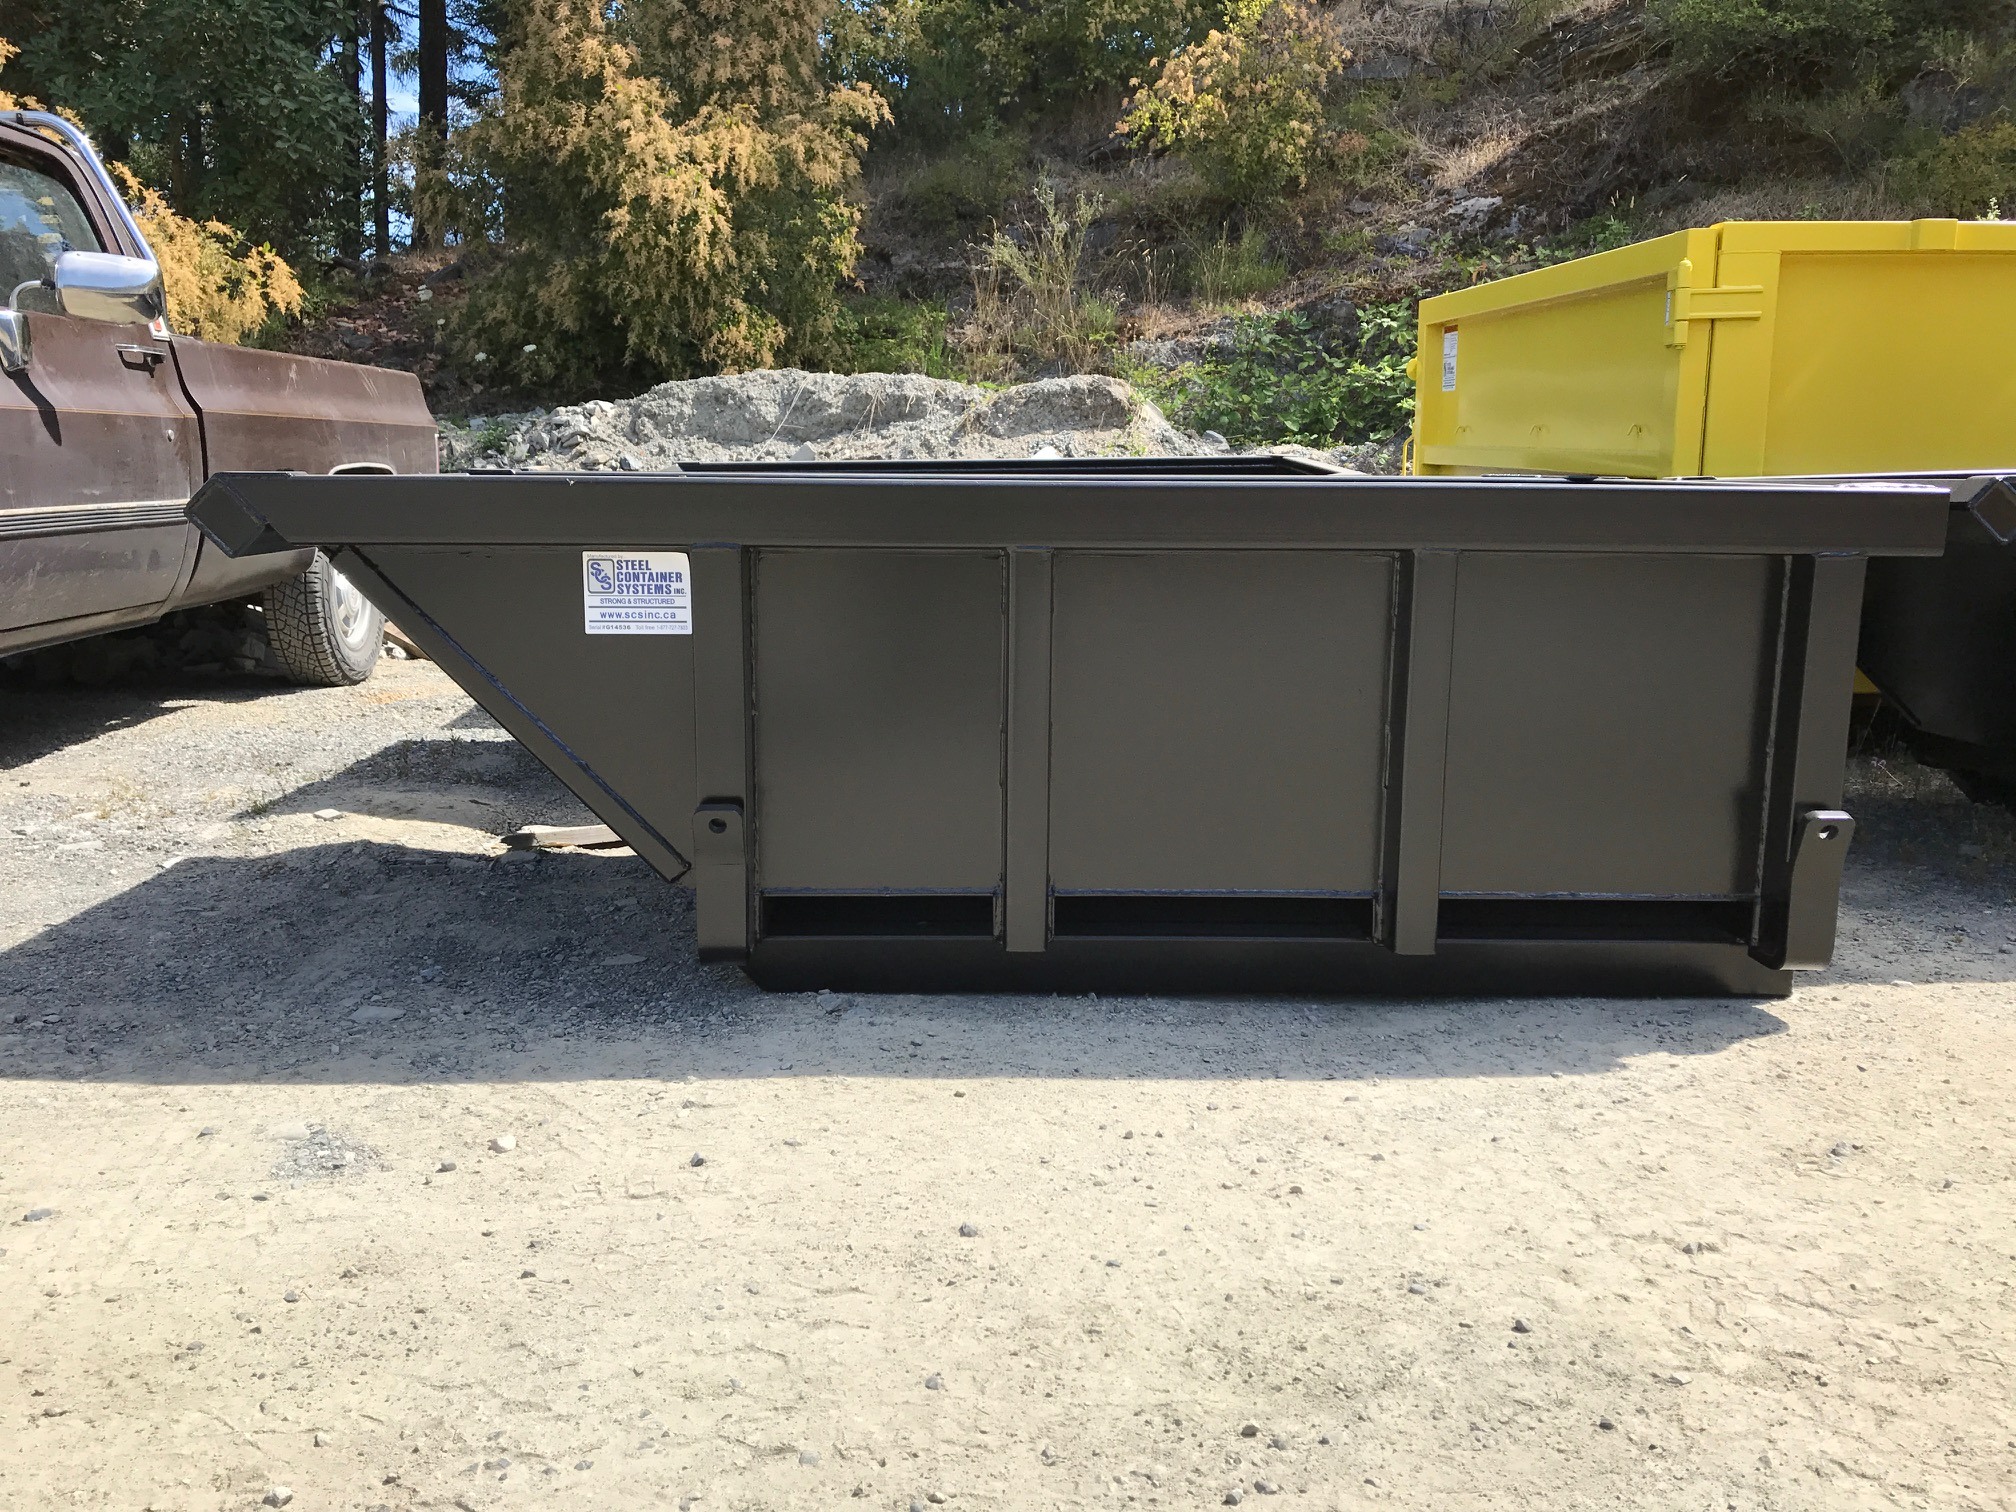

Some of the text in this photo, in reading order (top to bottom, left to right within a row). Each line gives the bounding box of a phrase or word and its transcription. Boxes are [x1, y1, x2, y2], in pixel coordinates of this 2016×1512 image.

[616, 560, 652, 571] STEEL
[616, 572, 683, 583] CONTAINER
[617, 584, 672, 595] SYSTEMS
[600, 610, 676, 619] www.scsinc.ca
